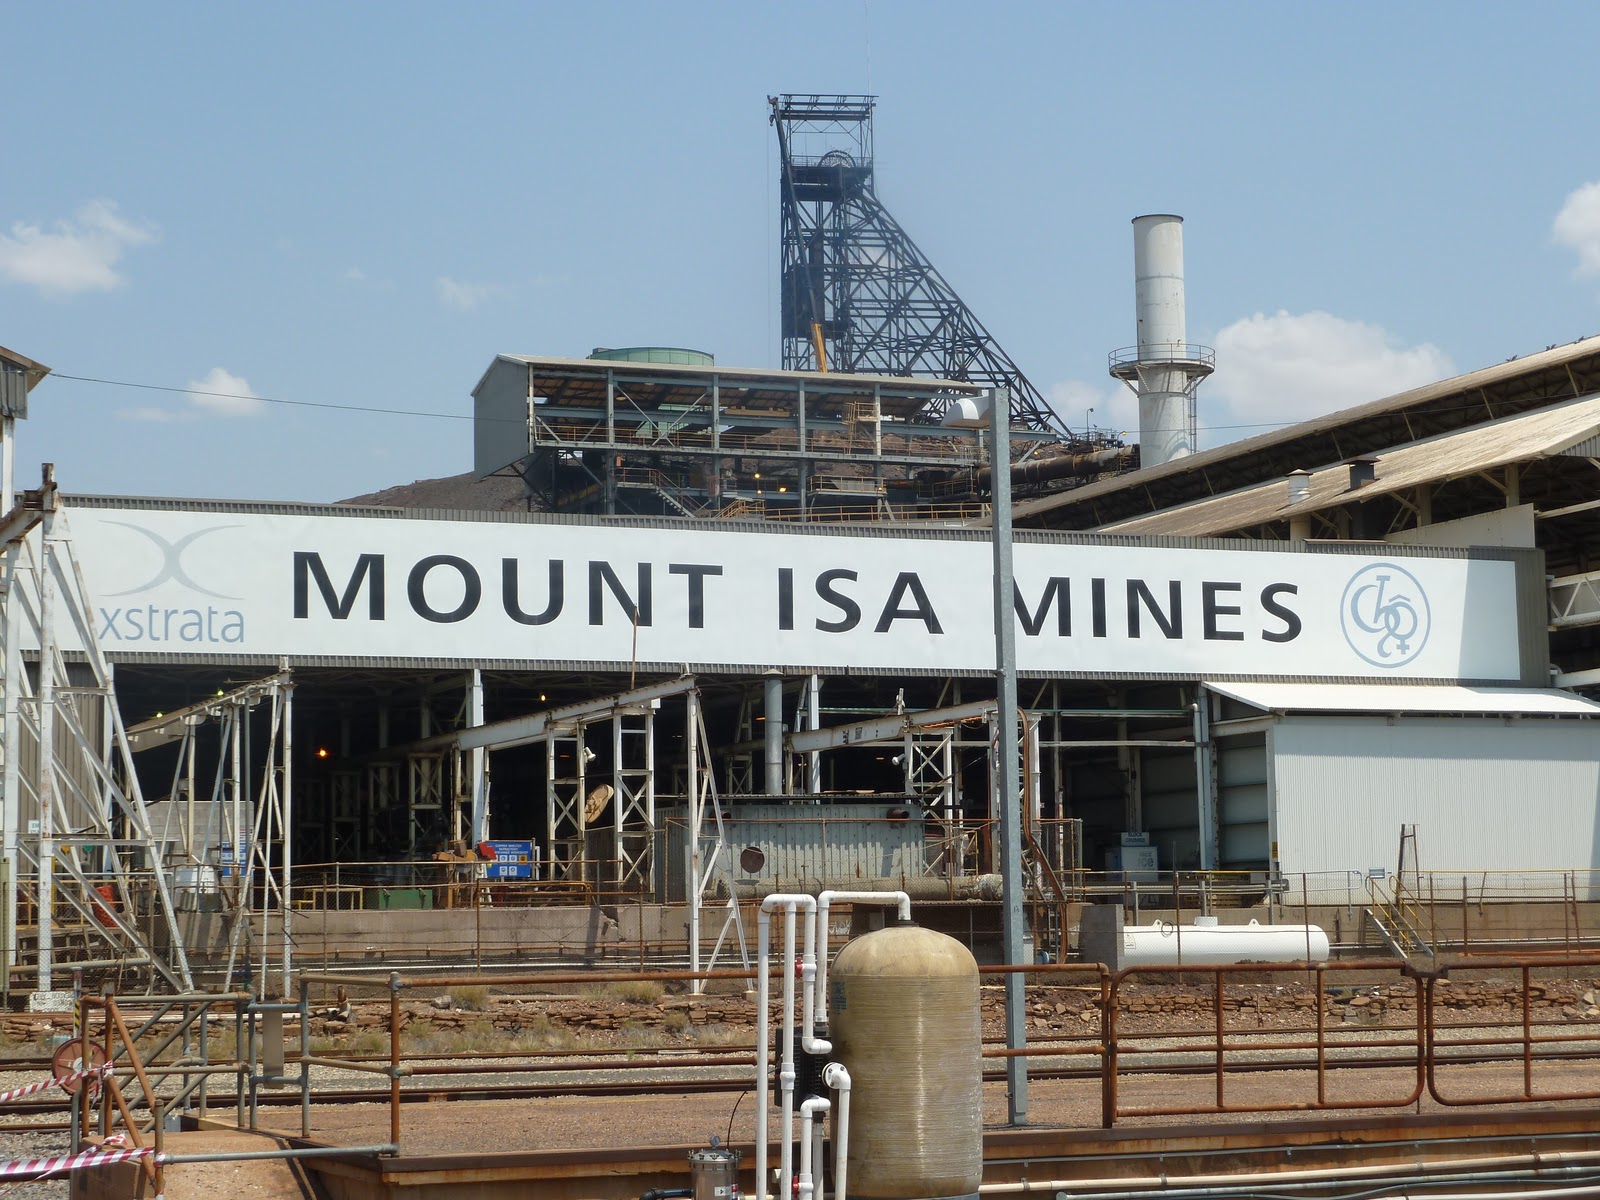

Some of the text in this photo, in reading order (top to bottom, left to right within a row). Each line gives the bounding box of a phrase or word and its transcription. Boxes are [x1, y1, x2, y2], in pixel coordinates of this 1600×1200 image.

[98, 604, 245, 643] xstrata
[293, 551, 1302, 643] MOUNT ISA MINES
